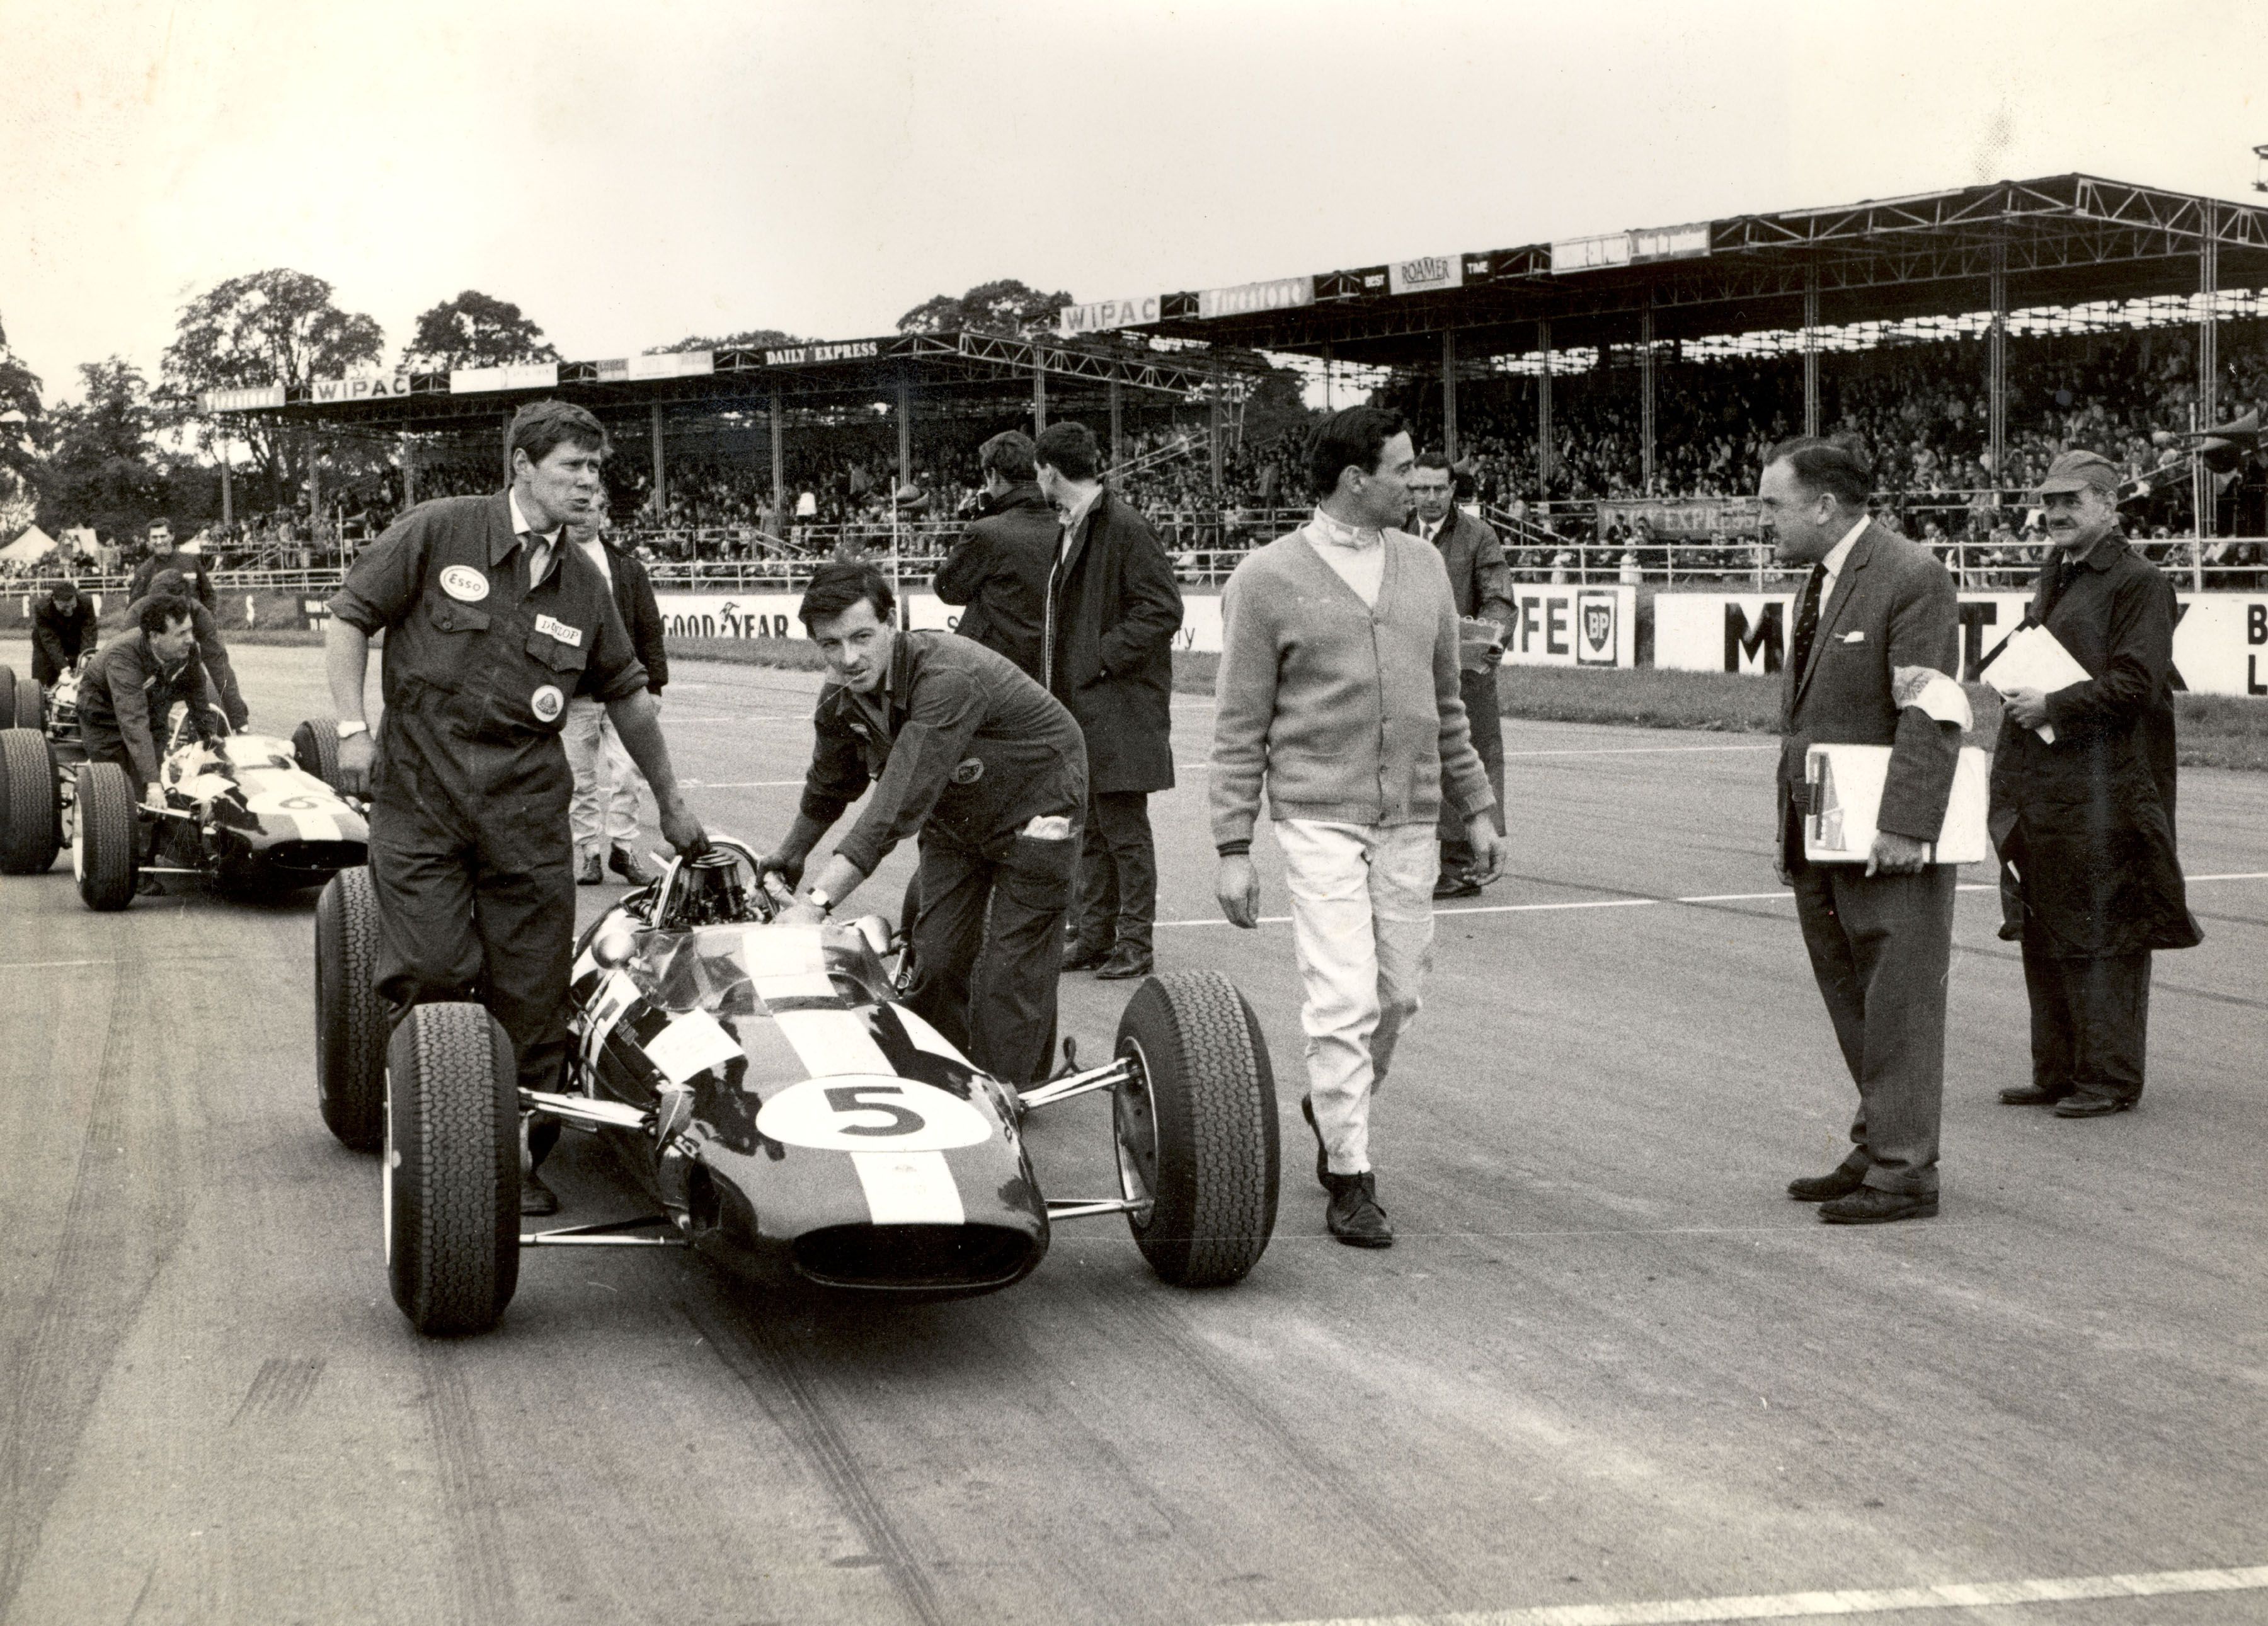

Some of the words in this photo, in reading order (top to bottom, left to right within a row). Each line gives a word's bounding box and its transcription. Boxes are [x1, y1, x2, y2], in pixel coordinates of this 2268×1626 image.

[1401, 258, 1450, 284] ROAMER
[1066, 297, 1156, 330] WIPAC
[765, 348, 806, 365] DAILY
[815, 341, 878, 361] EXPRESS
[318, 379, 407, 400] WIPAC
[661, 614, 715, 638] GOOD
[730, 614, 789, 638] YEAR
[1588, 612, 1608, 639] BP
[824, 1086, 925, 1136] 5
